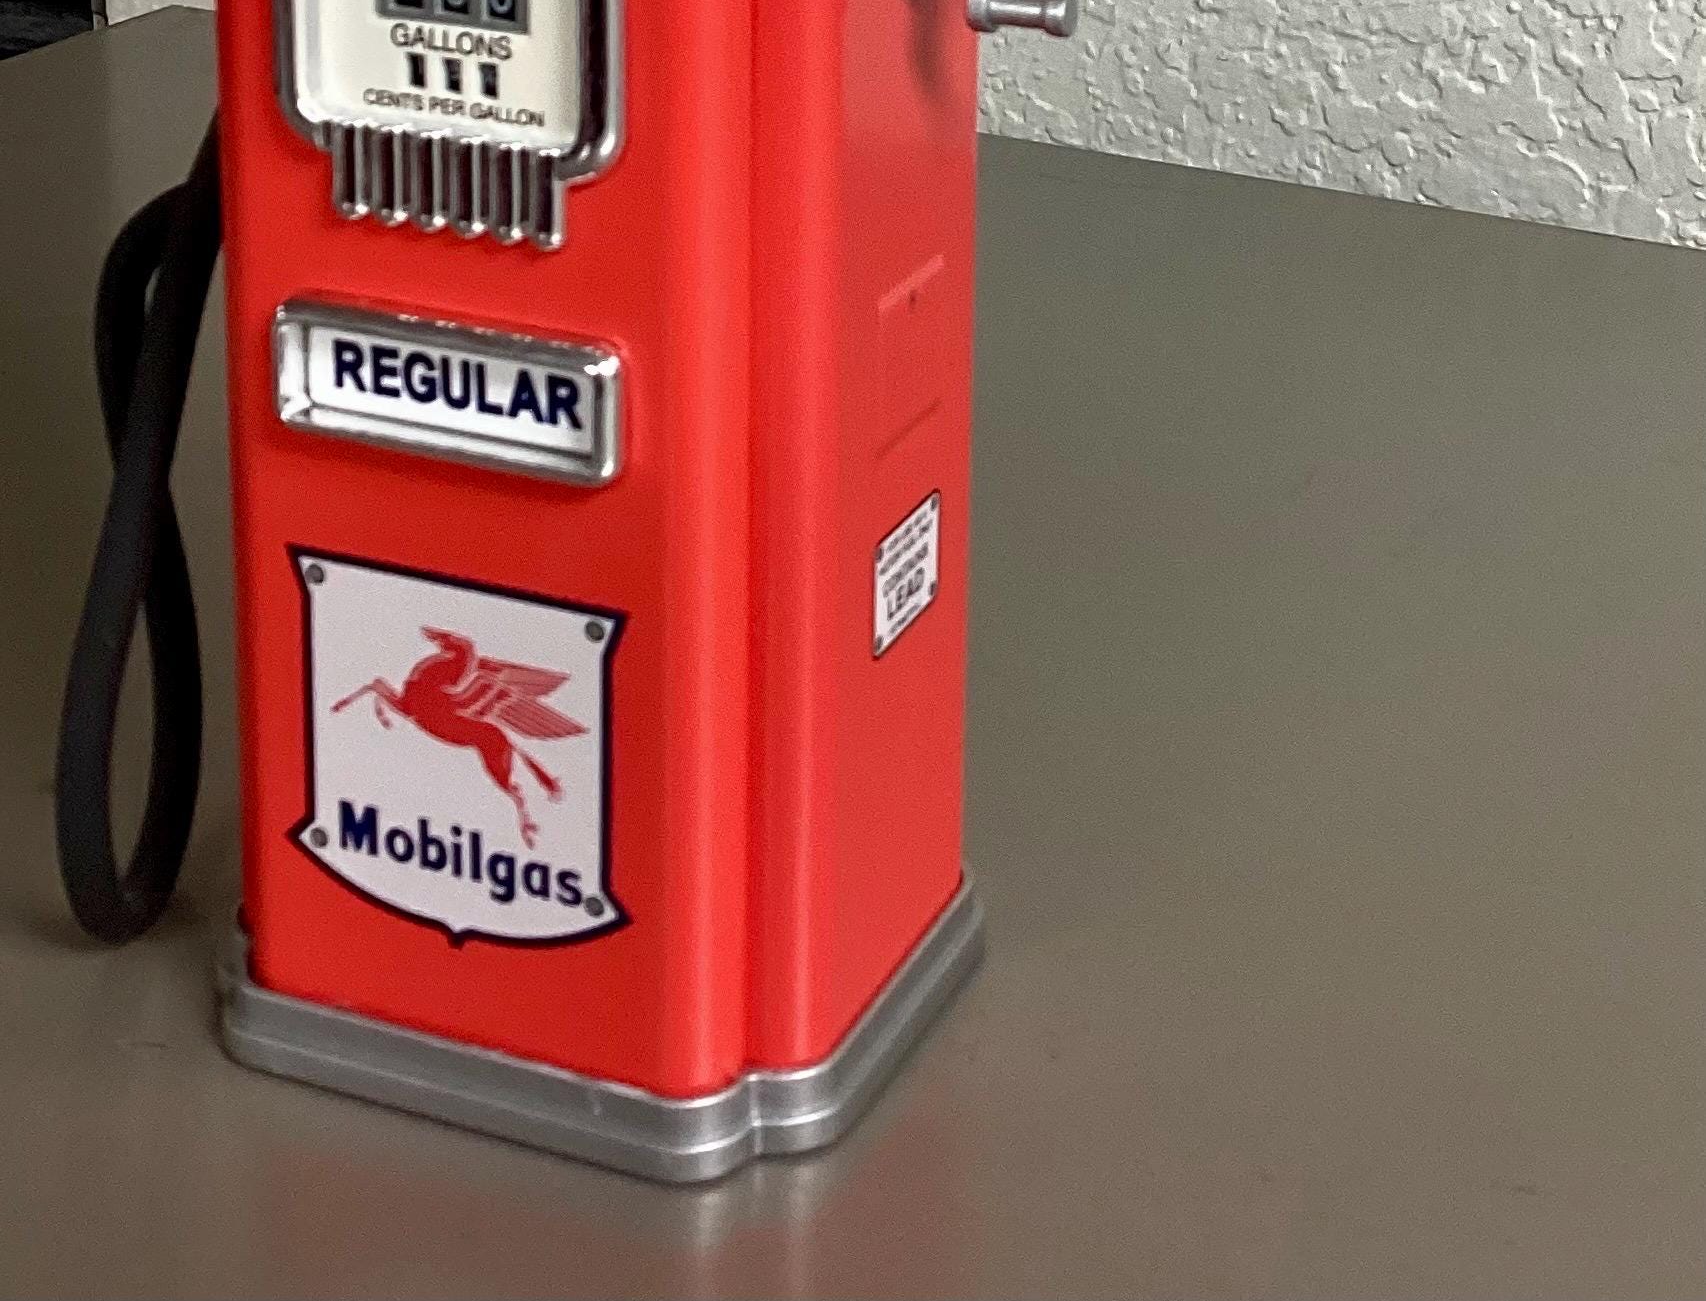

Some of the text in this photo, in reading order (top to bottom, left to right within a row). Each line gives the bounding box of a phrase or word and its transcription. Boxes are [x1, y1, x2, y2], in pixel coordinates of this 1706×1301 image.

[390, 23, 512, 60] GALLONS
[363, 88, 545, 126] CENTS PER GALLON
[333, 339, 582, 431] REGULAR
[887, 567, 925, 620] LEAD
[338, 800, 582, 906] Mobilgas
